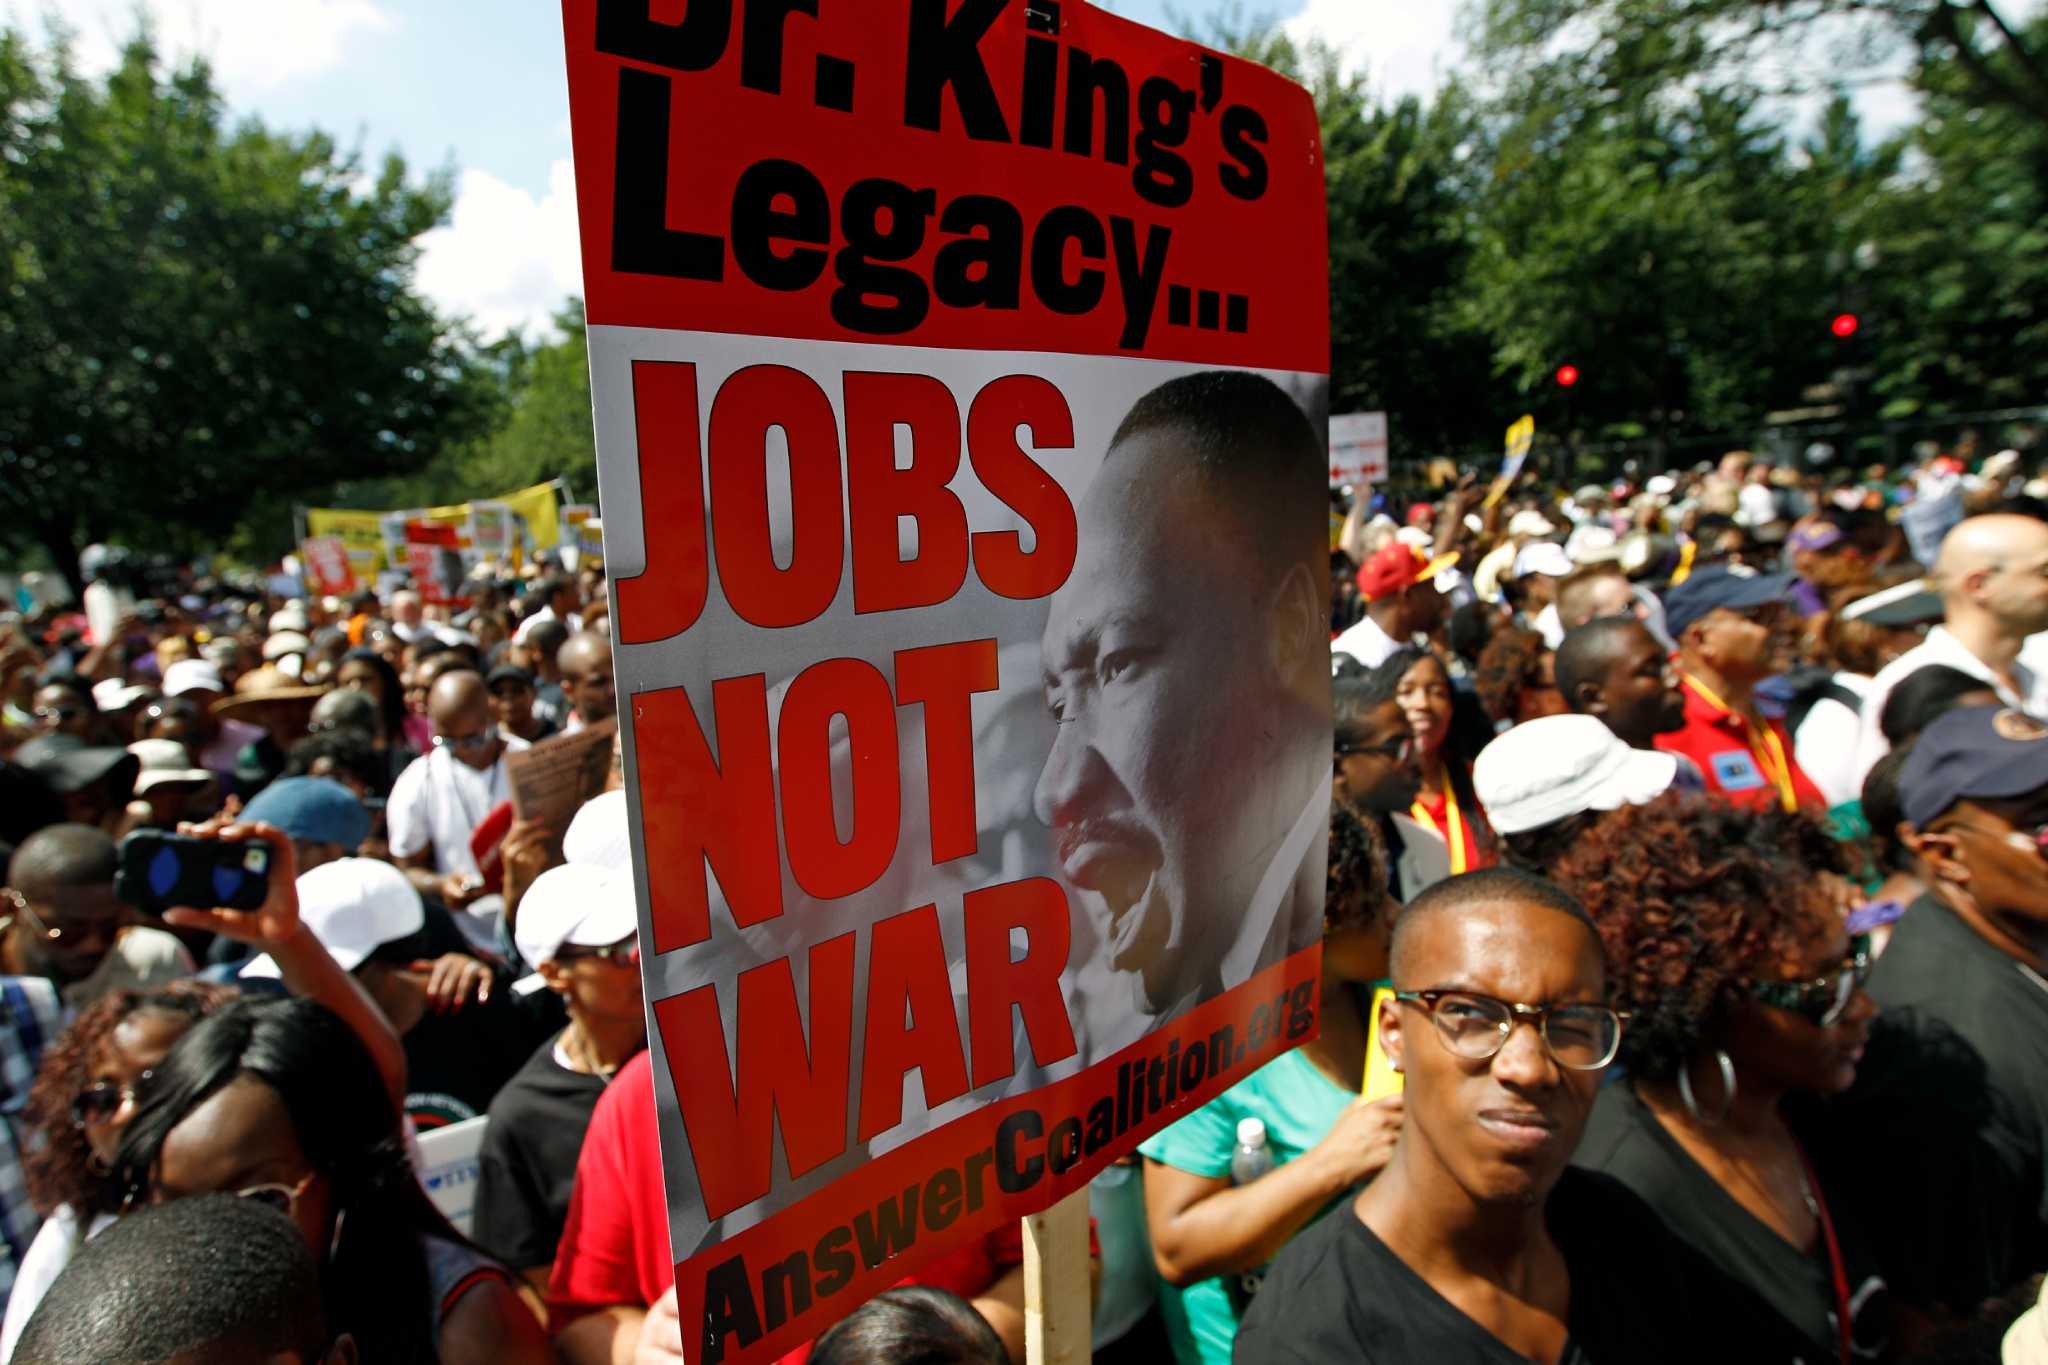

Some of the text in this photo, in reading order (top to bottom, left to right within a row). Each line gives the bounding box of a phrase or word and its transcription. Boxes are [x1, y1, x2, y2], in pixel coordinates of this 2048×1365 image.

[611, 66, 1249, 350] Legacy...
[904, 0, 1269, 208] King's
[615, 360, 1078, 645] JOBS
[630, 638, 999, 956] NOT
[653, 876, 1078, 1222] WAR
[702, 972, 1317, 1365] AnswerCoalition.org
